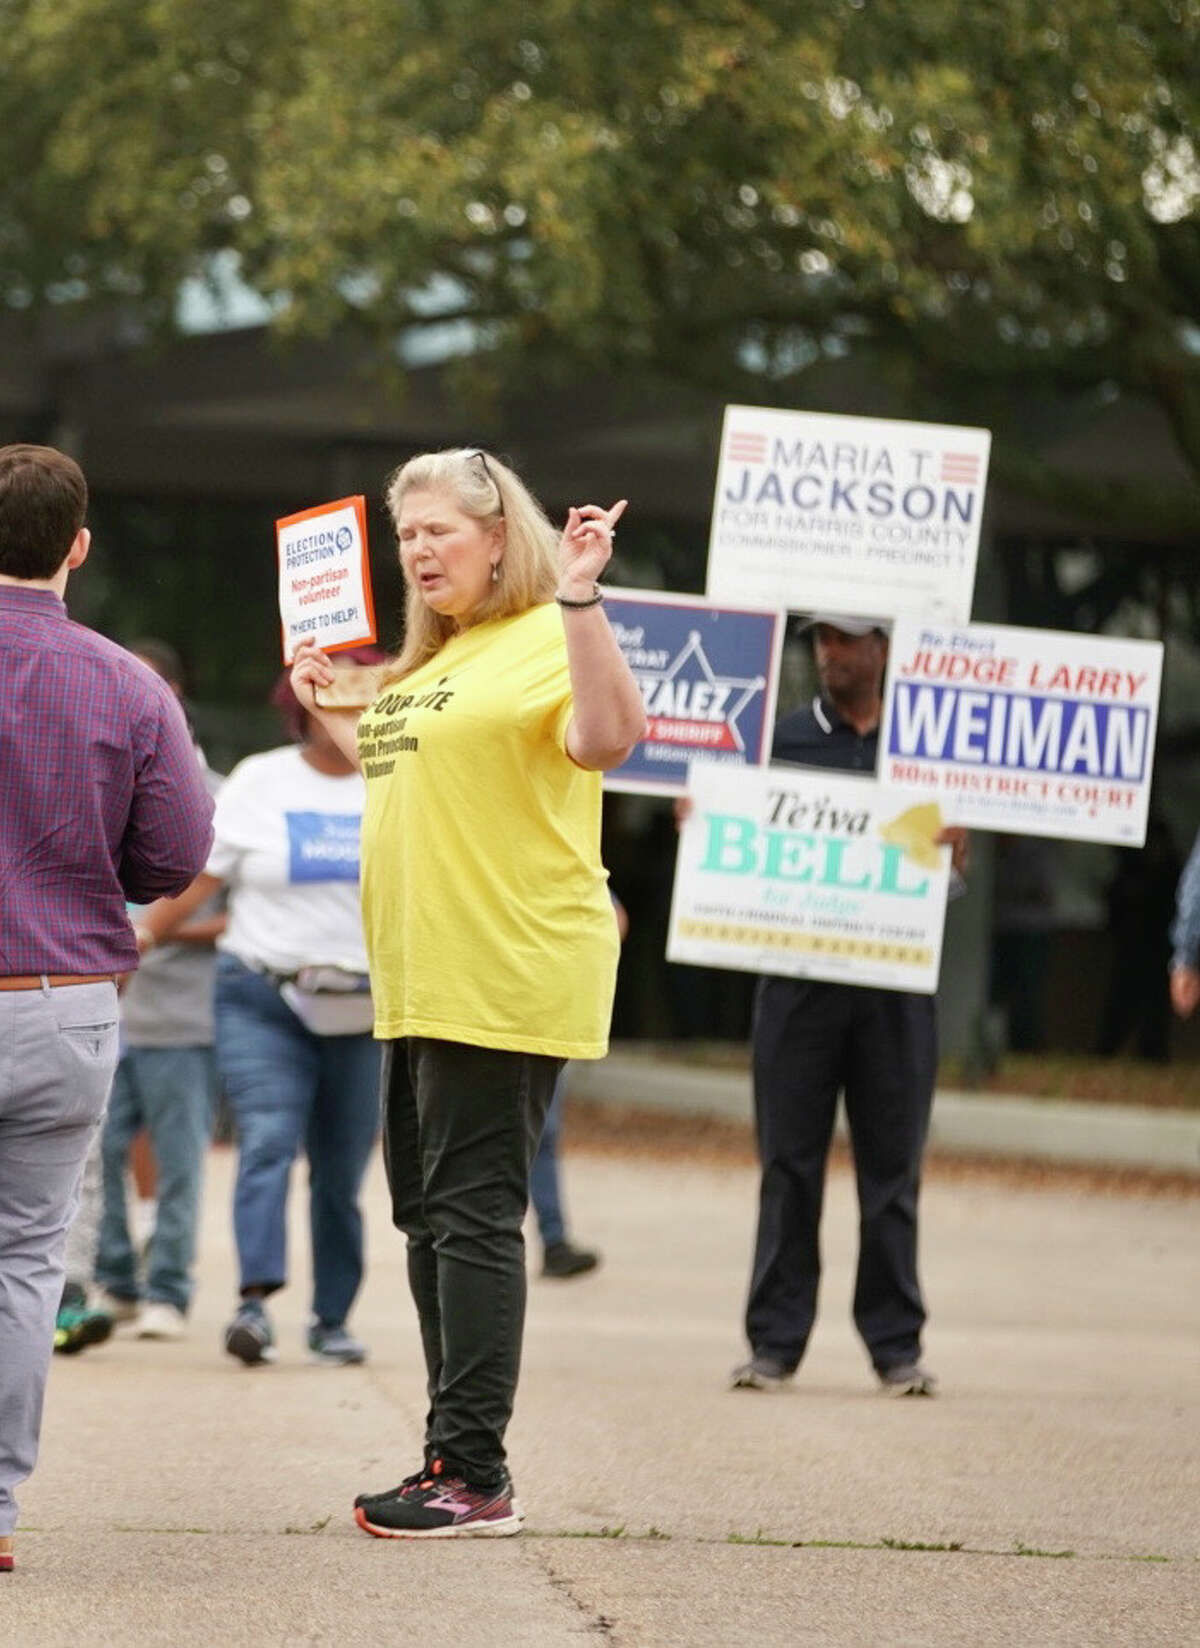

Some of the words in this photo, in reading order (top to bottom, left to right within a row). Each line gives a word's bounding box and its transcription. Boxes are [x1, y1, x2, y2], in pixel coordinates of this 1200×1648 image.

[773, 438, 894, 477] MARIA
[725, 469, 975, 523] JACKSON
[286, 531, 334, 556] ELECTION
[720, 510, 768, 527] FOR
[775, 514, 863, 539] HARRIS
[871, 523, 970, 547] COUNTY
[287, 546, 334, 570] PROTECTION
[292, 567, 349, 593] Non-partisan
[299, 585, 341, 606] volunteer
[299, 618, 317, 633] HERE
[318, 613, 330, 627] TO
[902, 650, 1018, 687] JUDGE
[1027, 662, 1148, 699] LARRY
[894, 683, 1147, 779] WEIMAN
[945, 770, 1049, 798] DISTRICT
[1057, 782, 1137, 808] COURT
[766, 787, 871, 836] Te'iva
[698, 812, 929, 899] BELL
